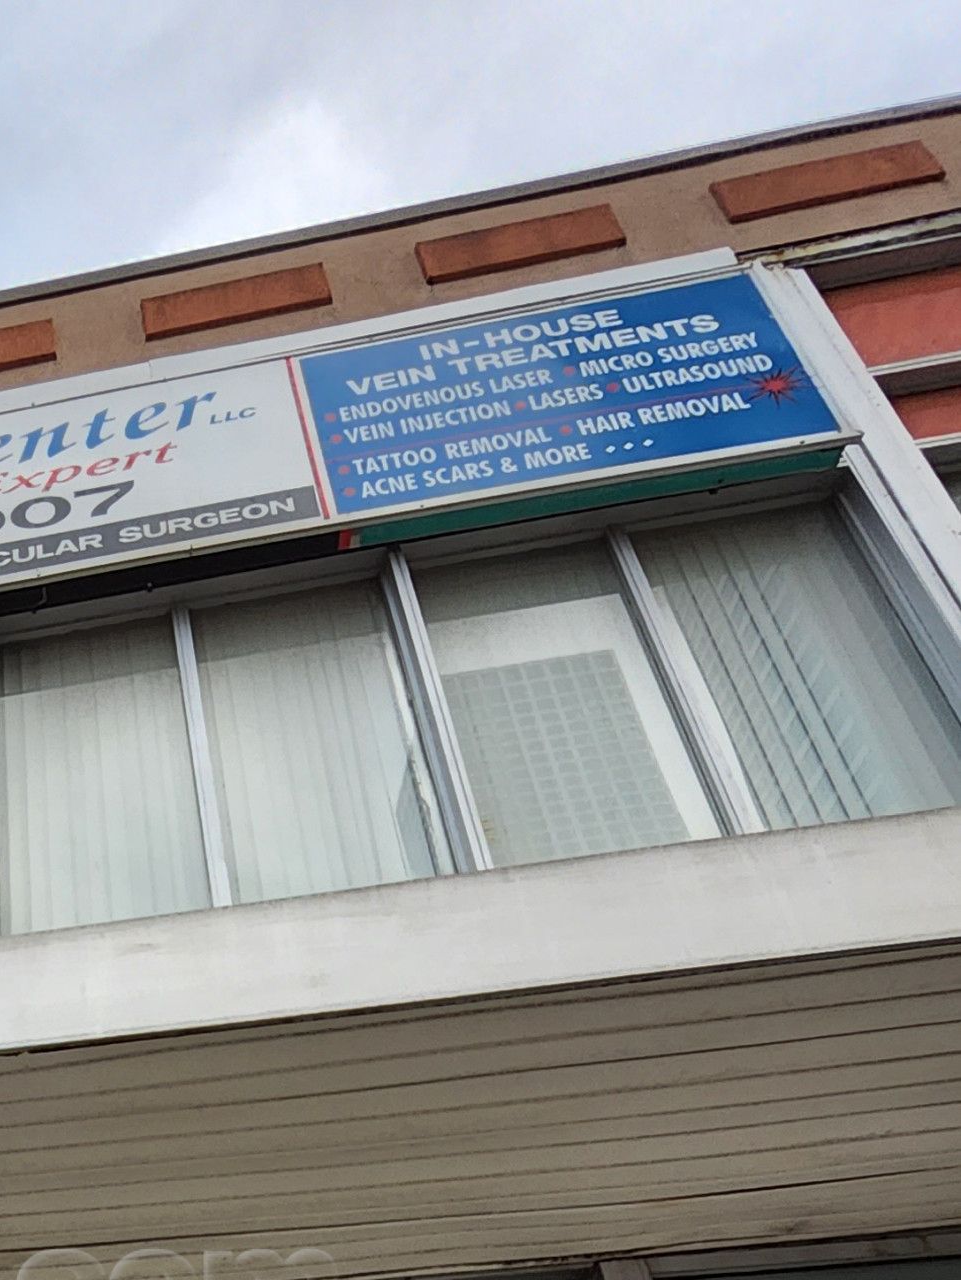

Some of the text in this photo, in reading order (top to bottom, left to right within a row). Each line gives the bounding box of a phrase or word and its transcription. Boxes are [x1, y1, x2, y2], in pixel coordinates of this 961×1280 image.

[346, 314, 721, 395] VEIN TREATMENTS
[419, 309, 624, 361] IN-HOUSE
[580, 332, 760, 378] MICRO SURGERY
[339, 369, 554, 423] ENDOVENOUS LASER
[529, 382, 604, 411] LASERS
[622, 353, 774, 395] ULTRASOUND
[209, 407, 257, 425] LLC
[344, 400, 511, 444] VEIN INJECTION
[576, 391, 752, 437] HAIR REMOVAL
[352, 426, 552, 477] TATTOO REMOVAL
[360, 441, 592, 500] ACNE SCARS & MORE
[117, 496, 297, 545] SURGEON
